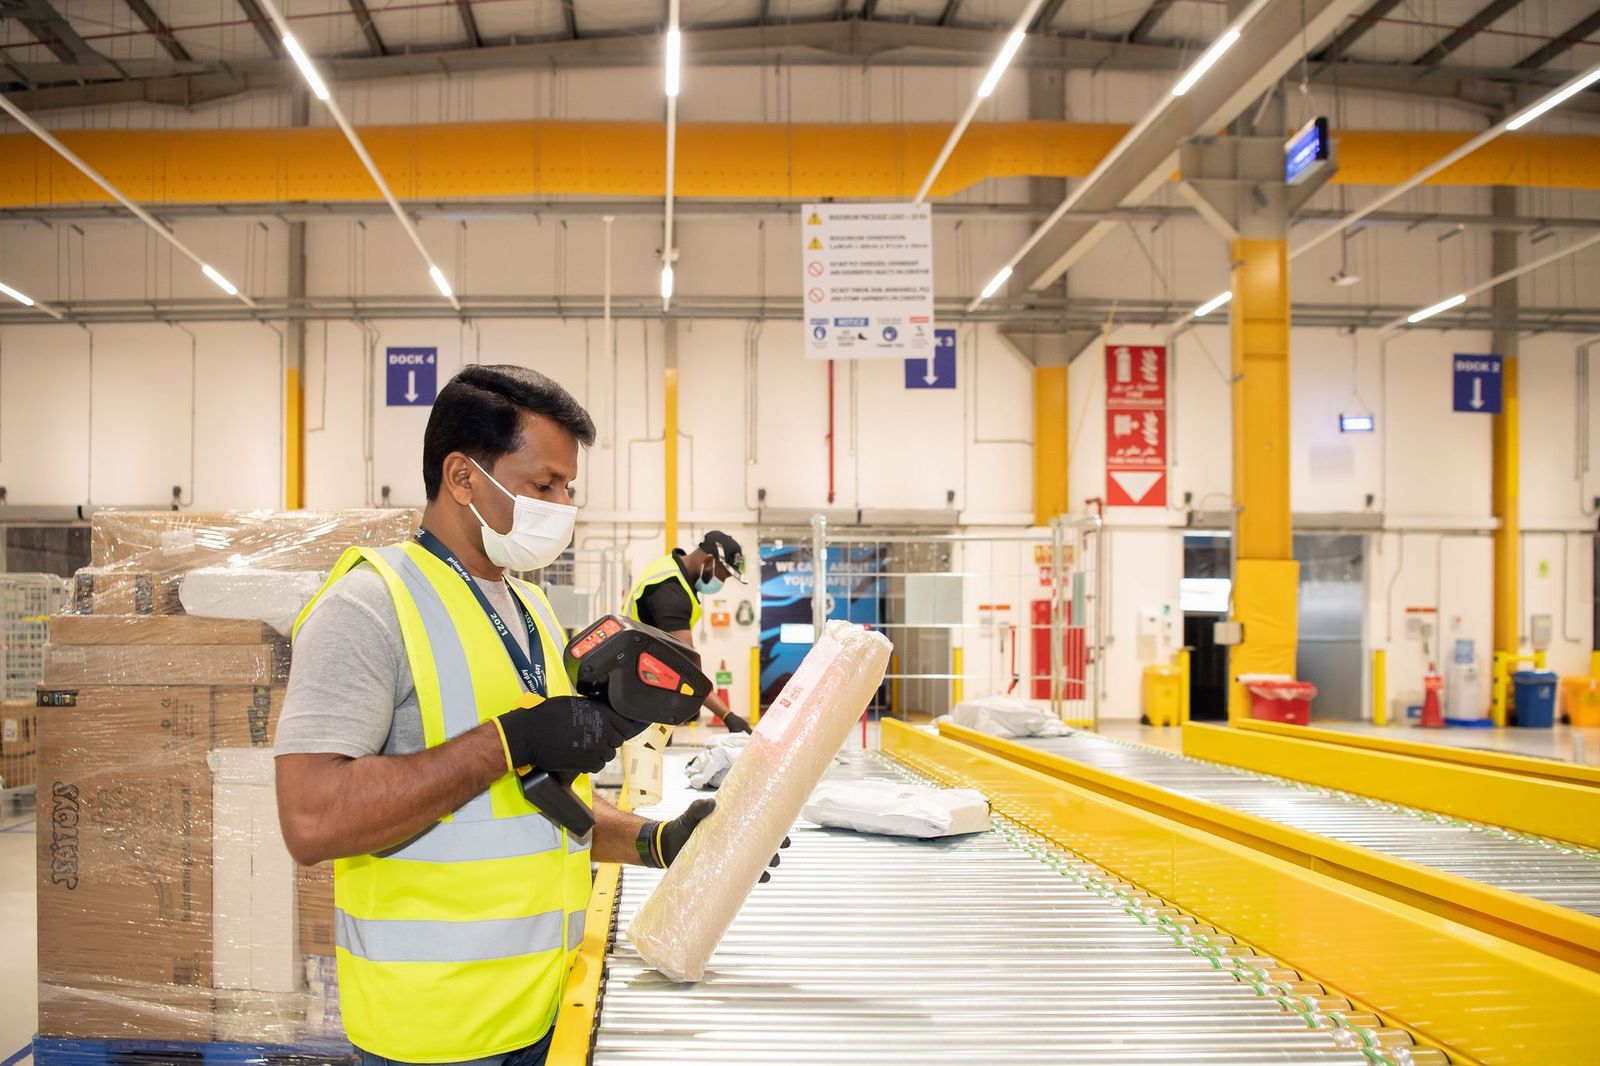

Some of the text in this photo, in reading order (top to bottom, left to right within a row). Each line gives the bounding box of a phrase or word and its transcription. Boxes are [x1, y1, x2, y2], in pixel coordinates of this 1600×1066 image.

[389, 354, 435, 365] DOCK 4
[1455, 359, 1489, 372] DOCK
[446, 556, 471, 582] prime day
[490, 612, 508, 636] 2021
[524, 612, 535, 634] 2021
